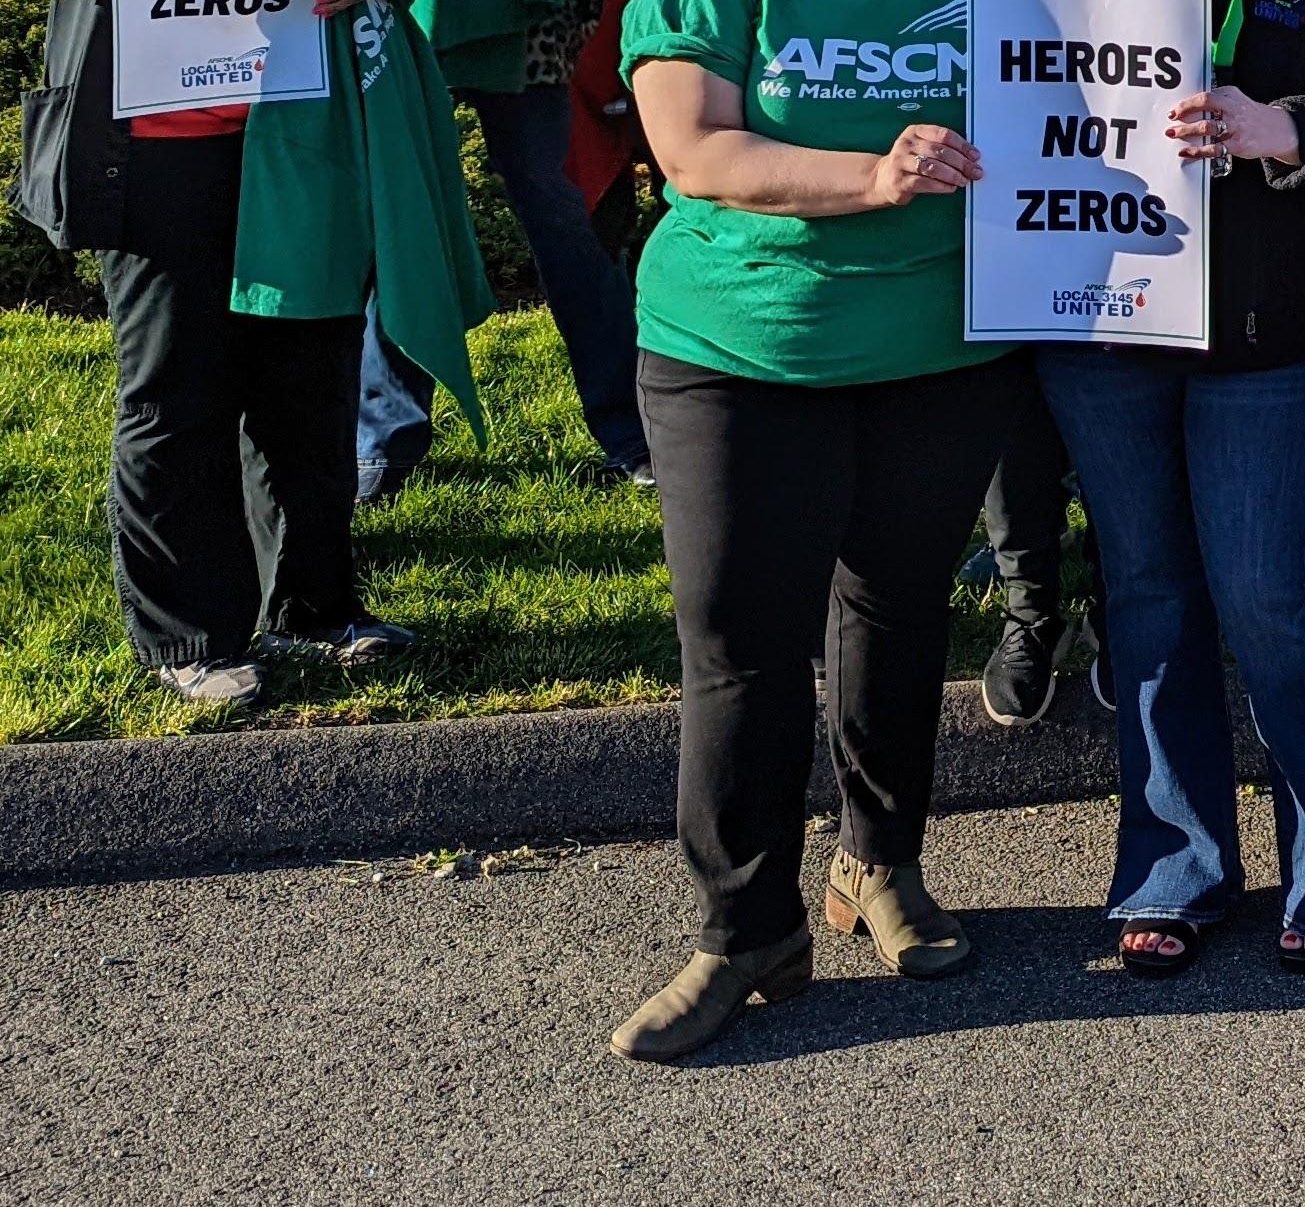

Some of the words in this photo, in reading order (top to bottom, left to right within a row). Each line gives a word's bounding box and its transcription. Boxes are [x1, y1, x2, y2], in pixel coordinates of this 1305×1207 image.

[181, 65, 220, 76] LOCAL
[224, 61, 253, 72] 3145
[762, 37, 967, 83] AFSCM
[1000, 40, 1182, 90] HEROES
[181, 72, 253, 88] UNITED
[760, 80, 791, 98] We
[799, 83, 857, 99] Make
[863, 84, 951, 99] America
[1041, 115, 1138, 160] NOT
[1016, 189, 1167, 237] ZEROS
[1084, 283, 1114, 291] AFSCME
[1053, 290, 1099, 302] LOCAL
[1102, 293, 1134, 304] 3145
[1053, 302, 1134, 318] UNITED
